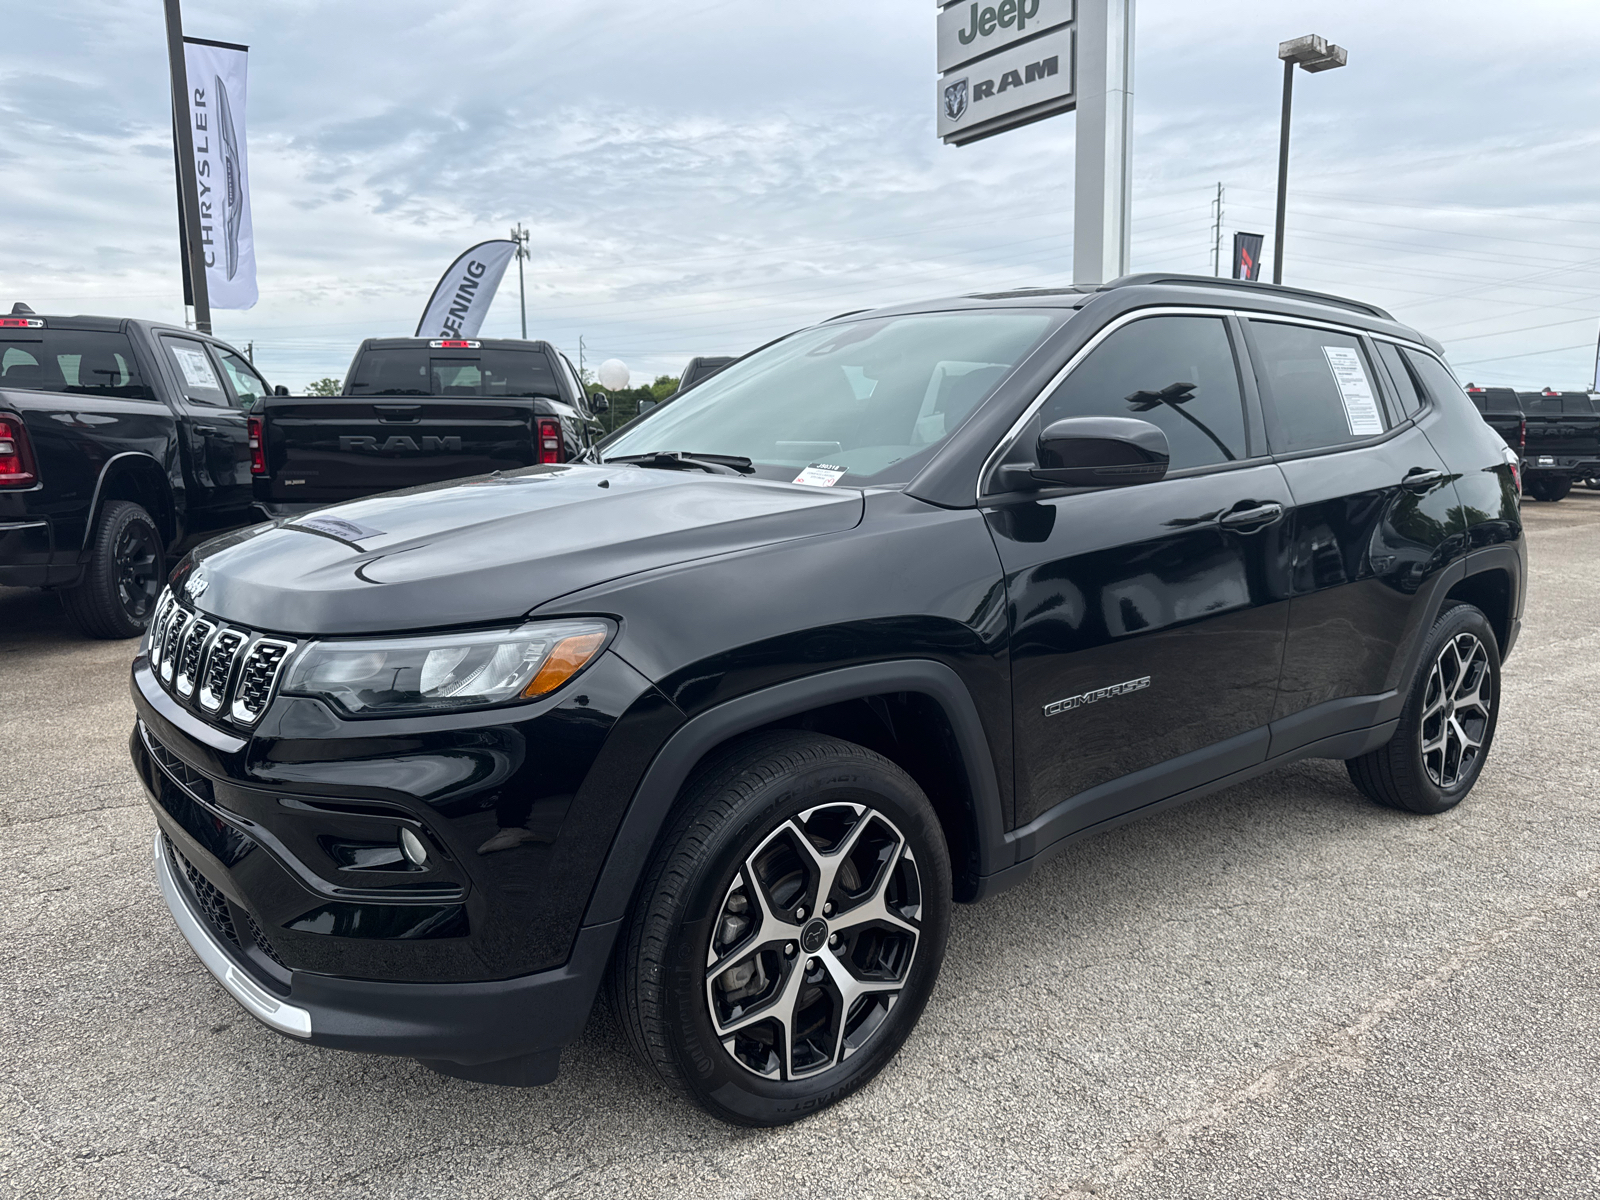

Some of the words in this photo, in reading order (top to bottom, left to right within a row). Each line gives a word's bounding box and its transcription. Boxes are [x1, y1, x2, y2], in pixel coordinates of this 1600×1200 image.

[958, 0, 1040, 45] Jeep
[973, 55, 1058, 102] RAM
[194, 87, 216, 268] CHRYSLER
[338, 435, 462, 451] RAM
[1042, 676, 1151, 717] COMPASS
